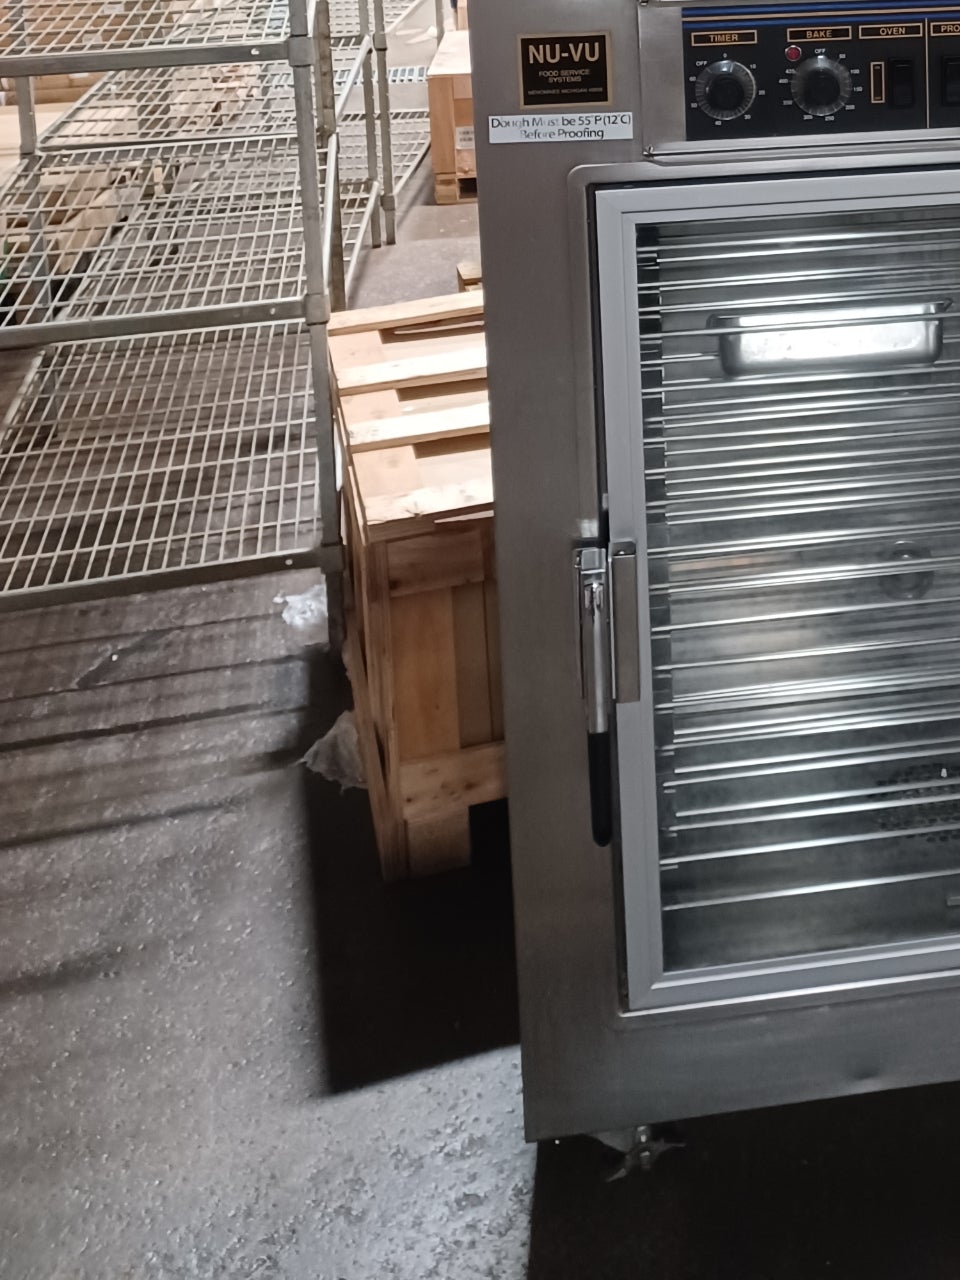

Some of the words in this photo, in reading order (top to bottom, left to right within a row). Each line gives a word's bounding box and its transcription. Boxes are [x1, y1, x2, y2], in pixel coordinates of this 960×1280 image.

[806, 29, 833, 39] BAKE
[880, 26, 906, 36] OVEN
[709, 33, 739, 42] TIMER
[528, 42, 600, 64] NU-VU
[538, 70, 559, 78] FOOD
[560, 68, 591, 77] SERVICE
[561, 115, 577, 126] be
[557, 127, 605, 140] Proofing
